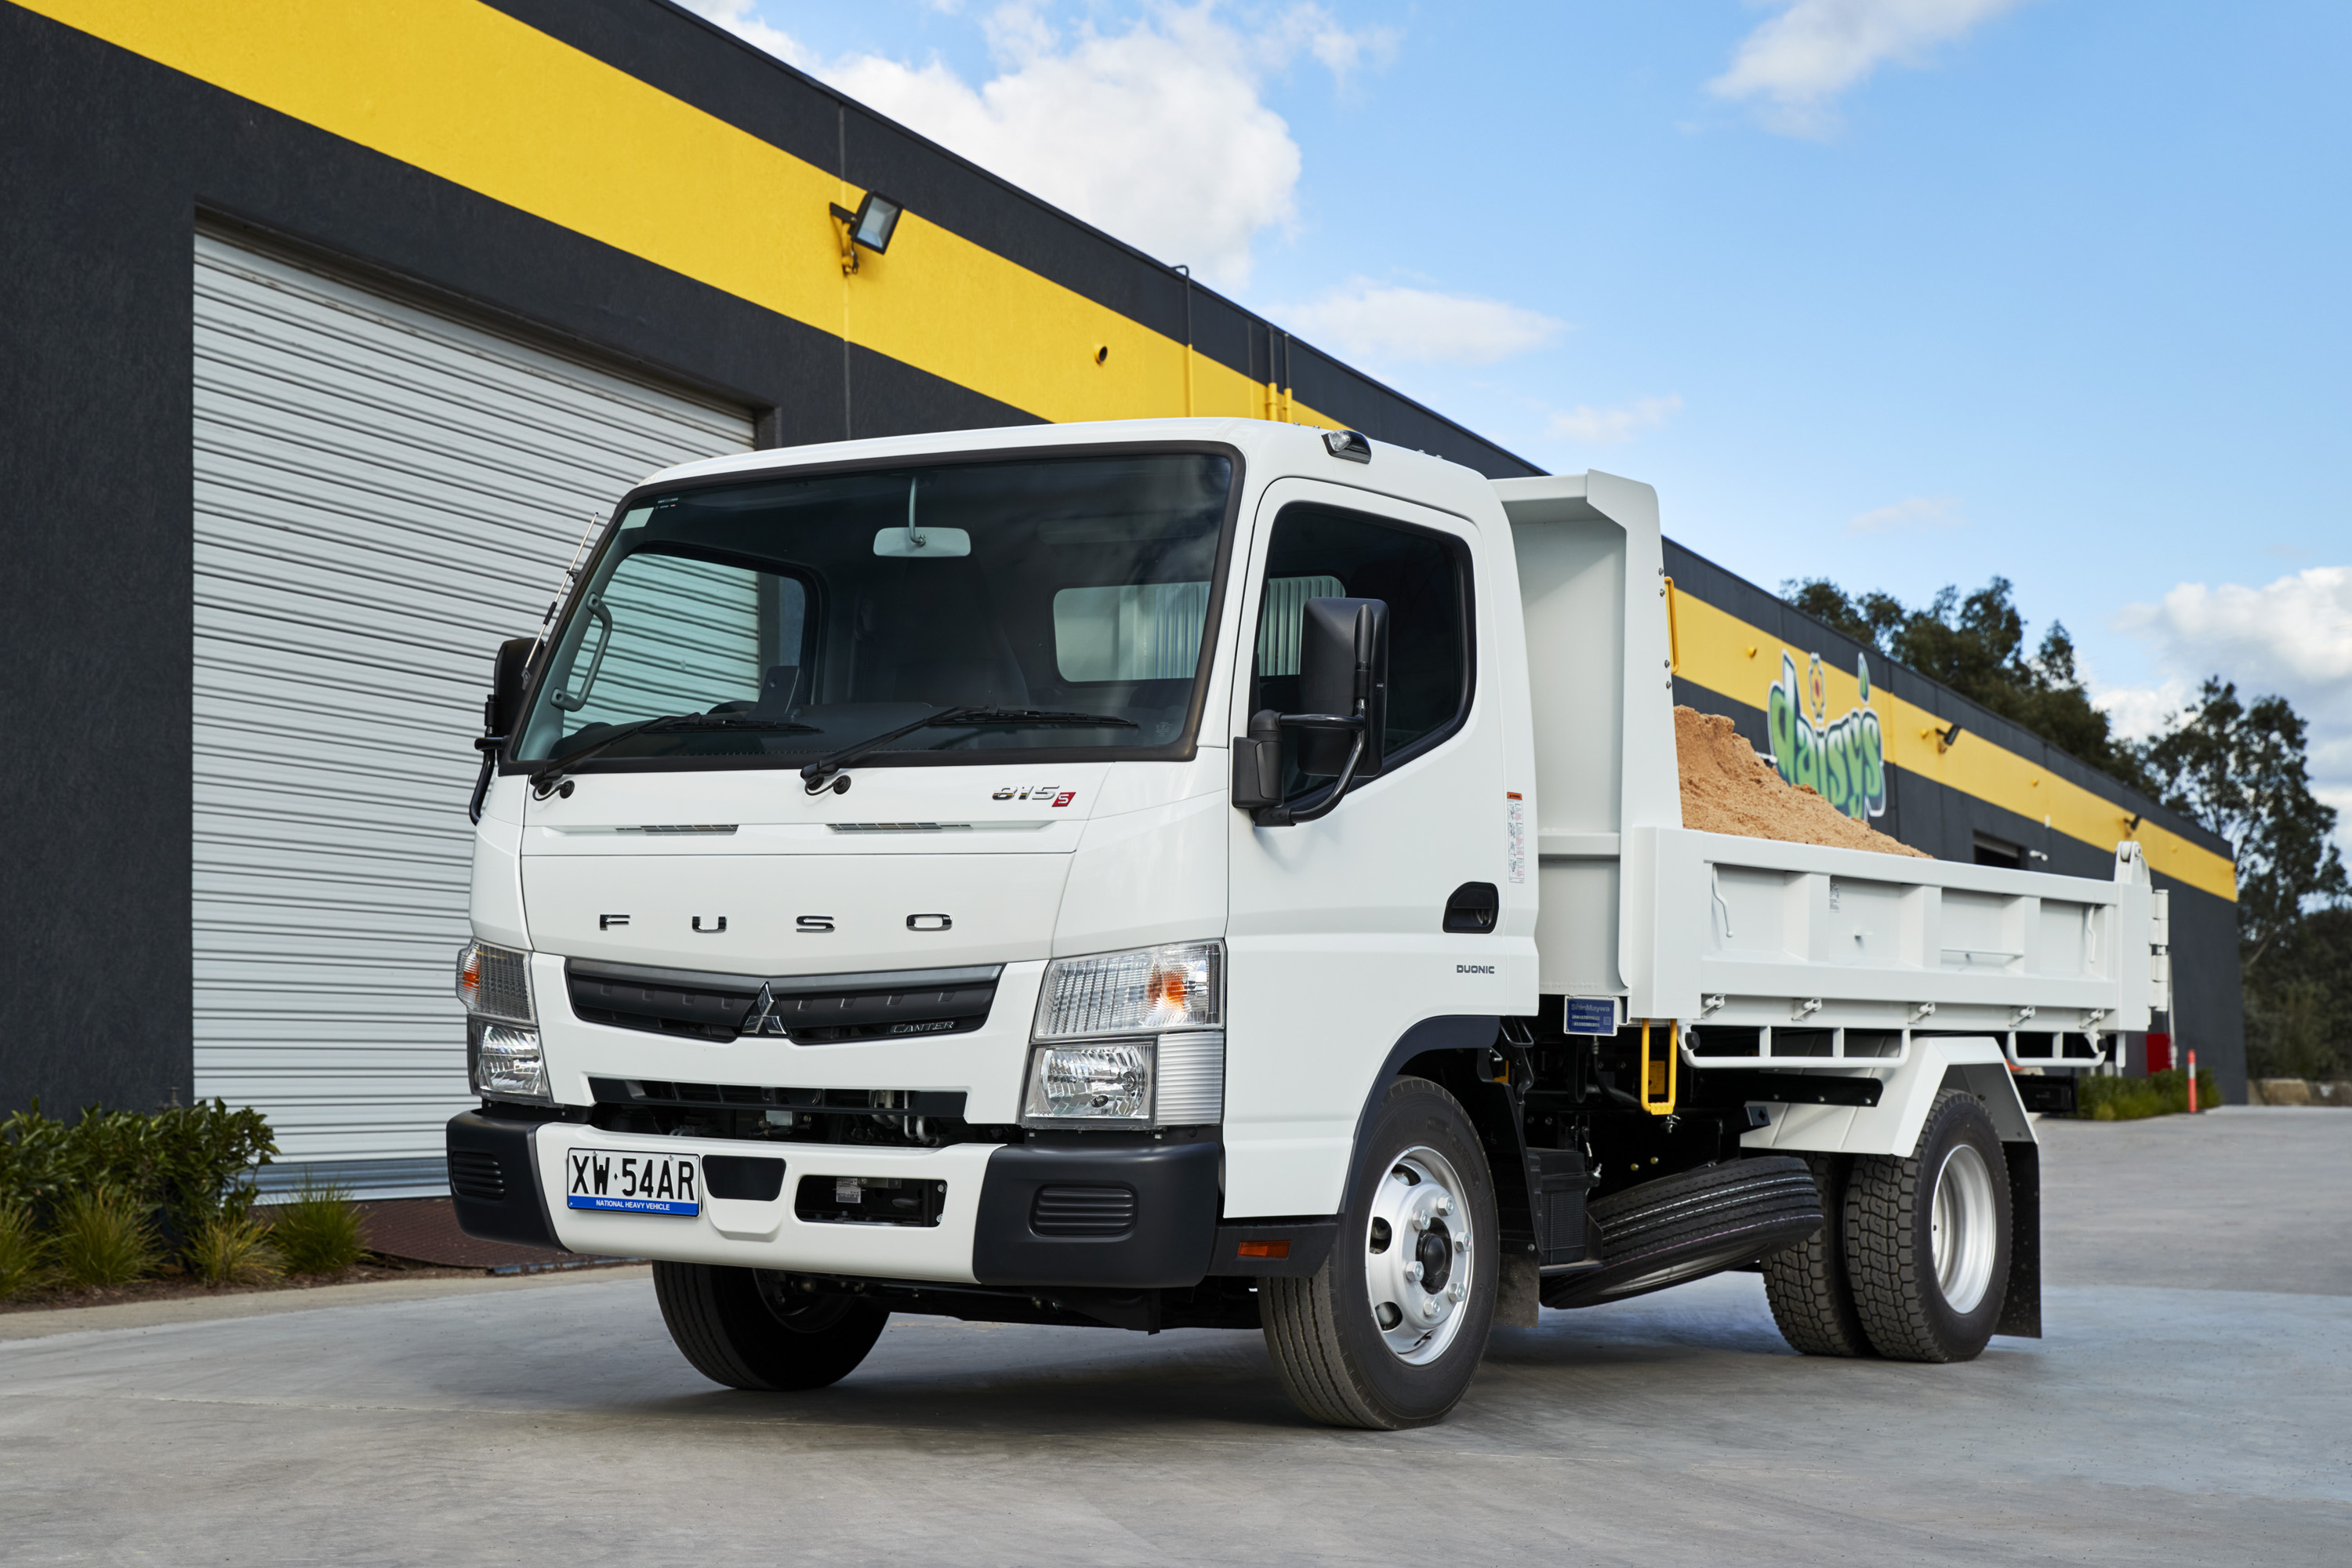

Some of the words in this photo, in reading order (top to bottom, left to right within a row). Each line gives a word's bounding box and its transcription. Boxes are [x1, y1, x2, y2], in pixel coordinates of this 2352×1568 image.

[992, 785, 1060, 800] 815
[600, 914, 953, 933] FUSO
[1457, 965, 1494, 974] DUONIC
[1571, 1004, 1610, 1012] ShinMaywa
[891, 1022, 954, 1033] CANTER
[596, 1200, 624, 1208] NATIONAL
